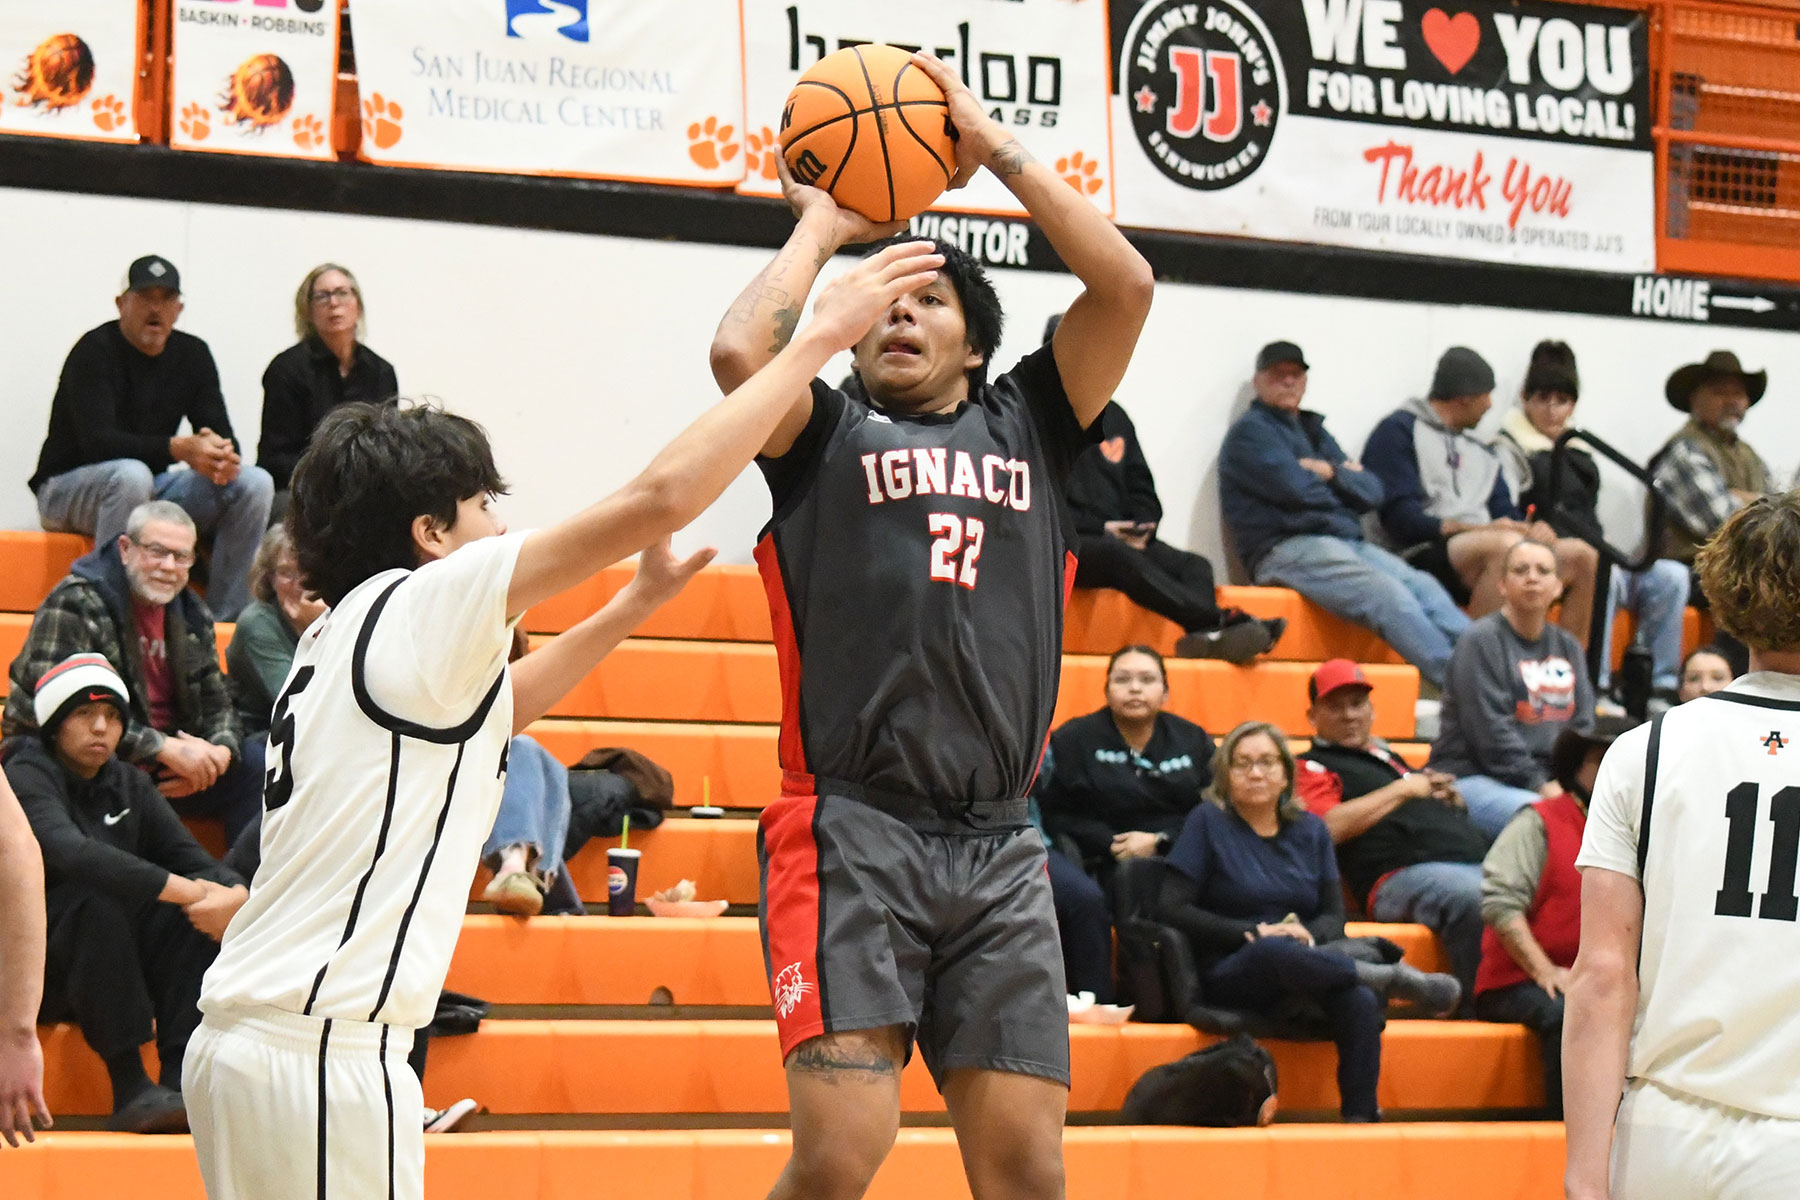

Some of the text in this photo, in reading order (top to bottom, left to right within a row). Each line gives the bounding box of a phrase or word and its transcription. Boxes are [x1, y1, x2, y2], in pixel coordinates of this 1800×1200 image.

[179, 8, 326, 37] BASKIN ROBBINS
[1137, 4, 1271, 86] JIMMY JOHN'S
[1303, 0, 1634, 95] WE YOU
[411, 46, 679, 95] SAN JUAN REGIONAL
[1166, 45, 1243, 143] JJ
[1307, 68, 1636, 141] FOR LOVING LOCAL!
[427, 88, 665, 131] MEDICAL CENTER
[988, 107, 1058, 128] ASS
[1362, 140, 1573, 230] Thank You
[1313, 206, 1351, 229] FROM
[1357, 210, 1391, 233] YOUR
[1396, 215, 1451, 240] LOCALLY
[1456, 222, 1503, 242] OWNED
[1521, 227, 1589, 250] OPERATED
[1631, 275, 1711, 321] HOME
[928, 512, 985, 590] 22
[1714, 782, 1800, 922] 11
